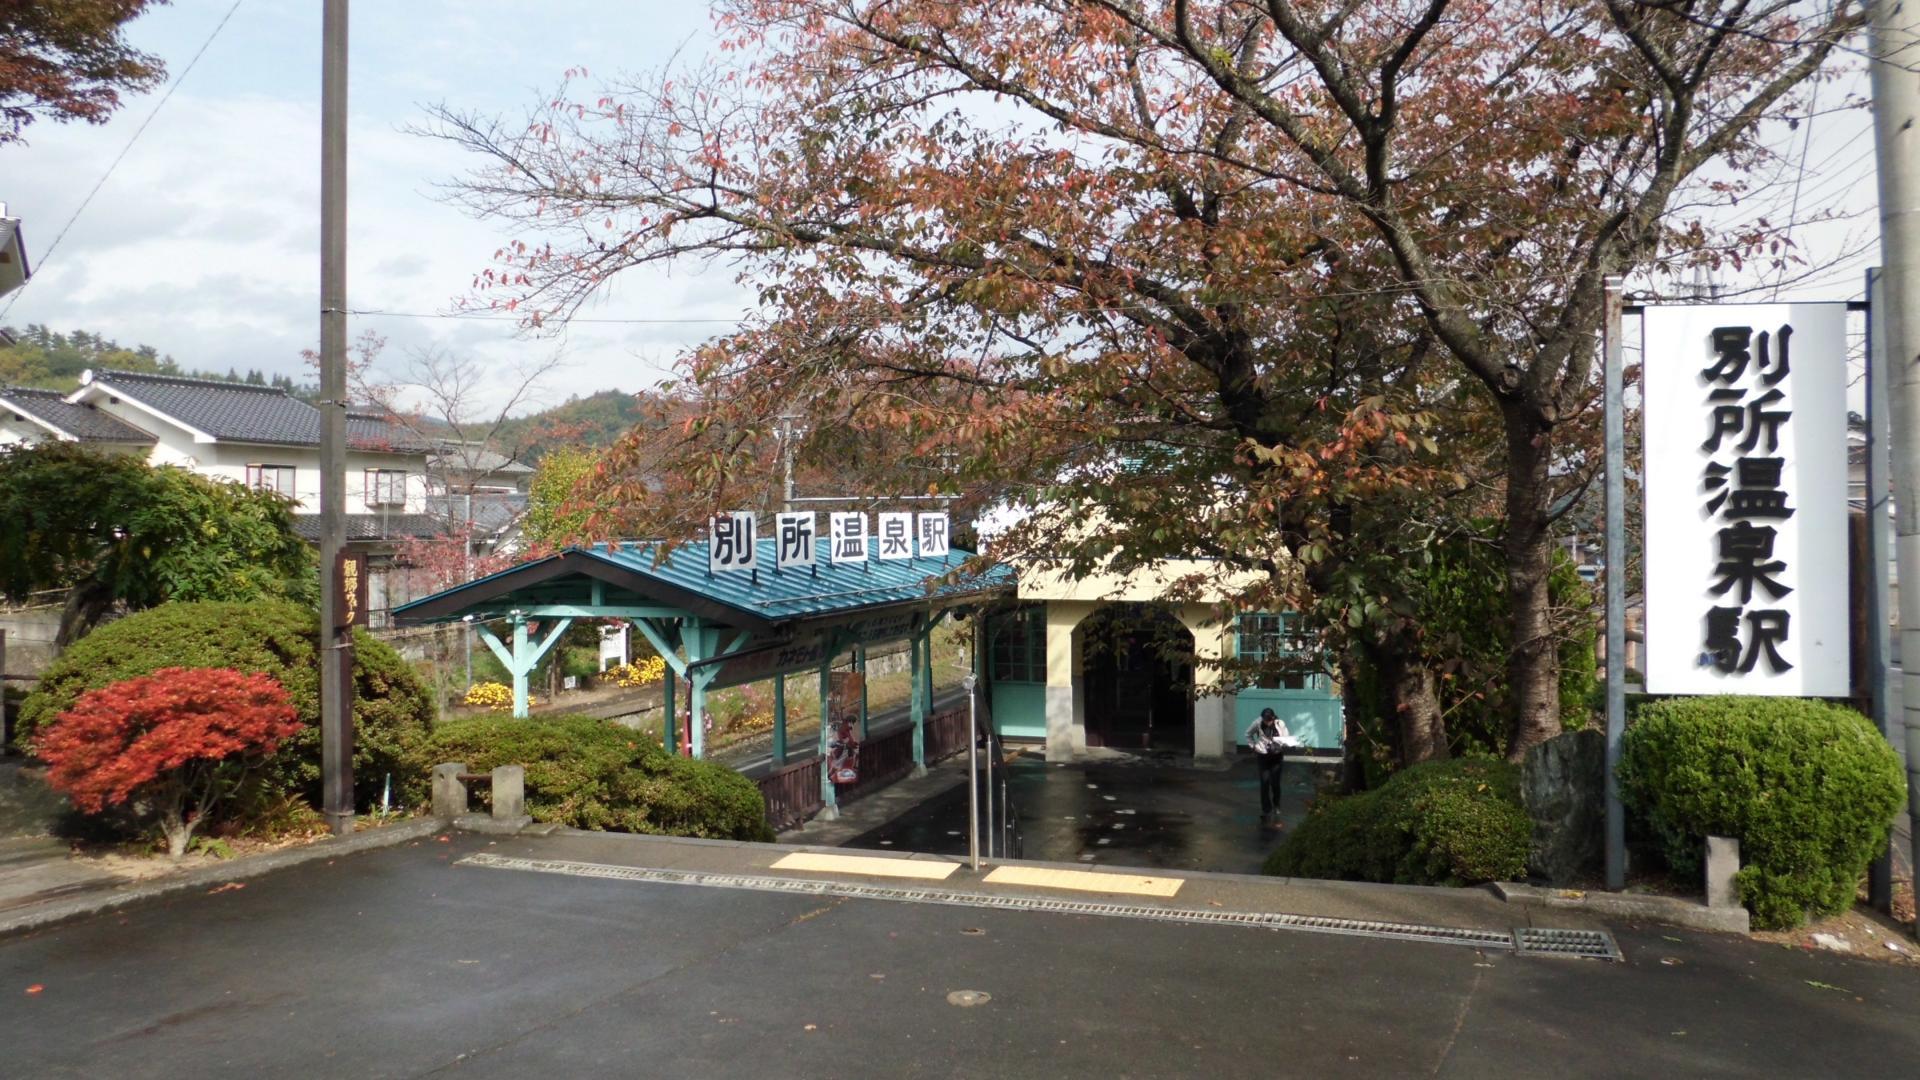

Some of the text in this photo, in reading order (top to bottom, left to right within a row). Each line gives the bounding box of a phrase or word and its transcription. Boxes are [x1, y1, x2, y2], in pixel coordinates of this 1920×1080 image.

[714, 516, 946, 565] 別所温泉駅
[1701, 323, 1795, 673] 別所温泉駅
